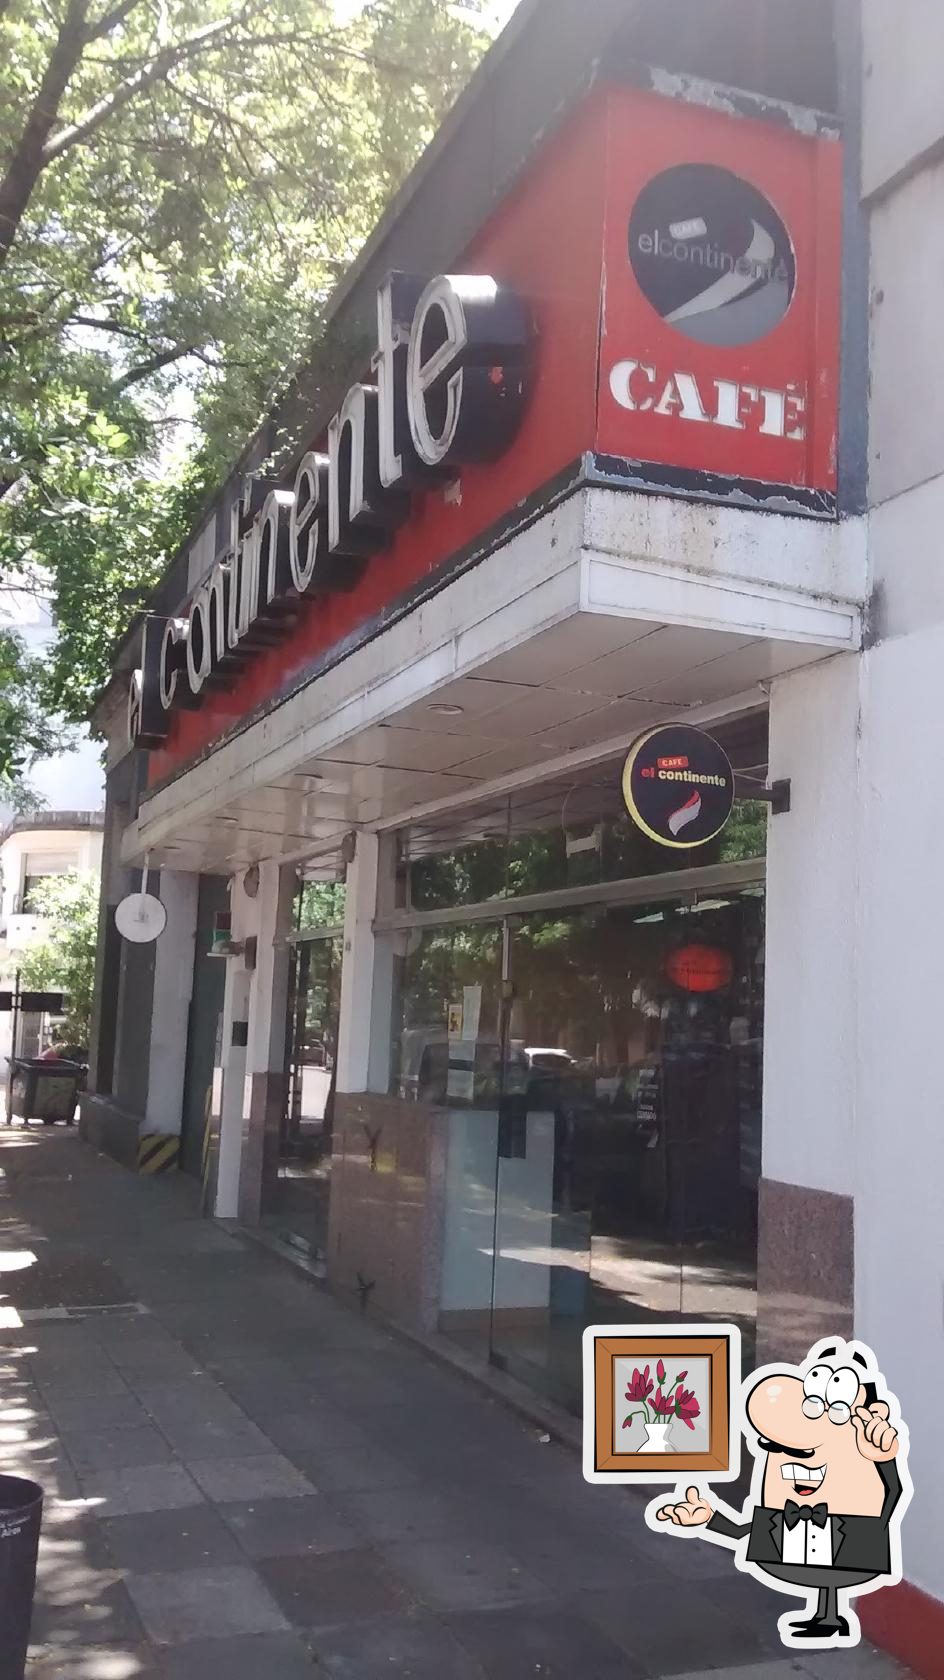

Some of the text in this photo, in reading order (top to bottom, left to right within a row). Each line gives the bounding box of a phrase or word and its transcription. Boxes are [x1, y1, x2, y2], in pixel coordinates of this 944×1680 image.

[160, 272, 473, 710] continente
[641, 767, 726, 787] el continente
